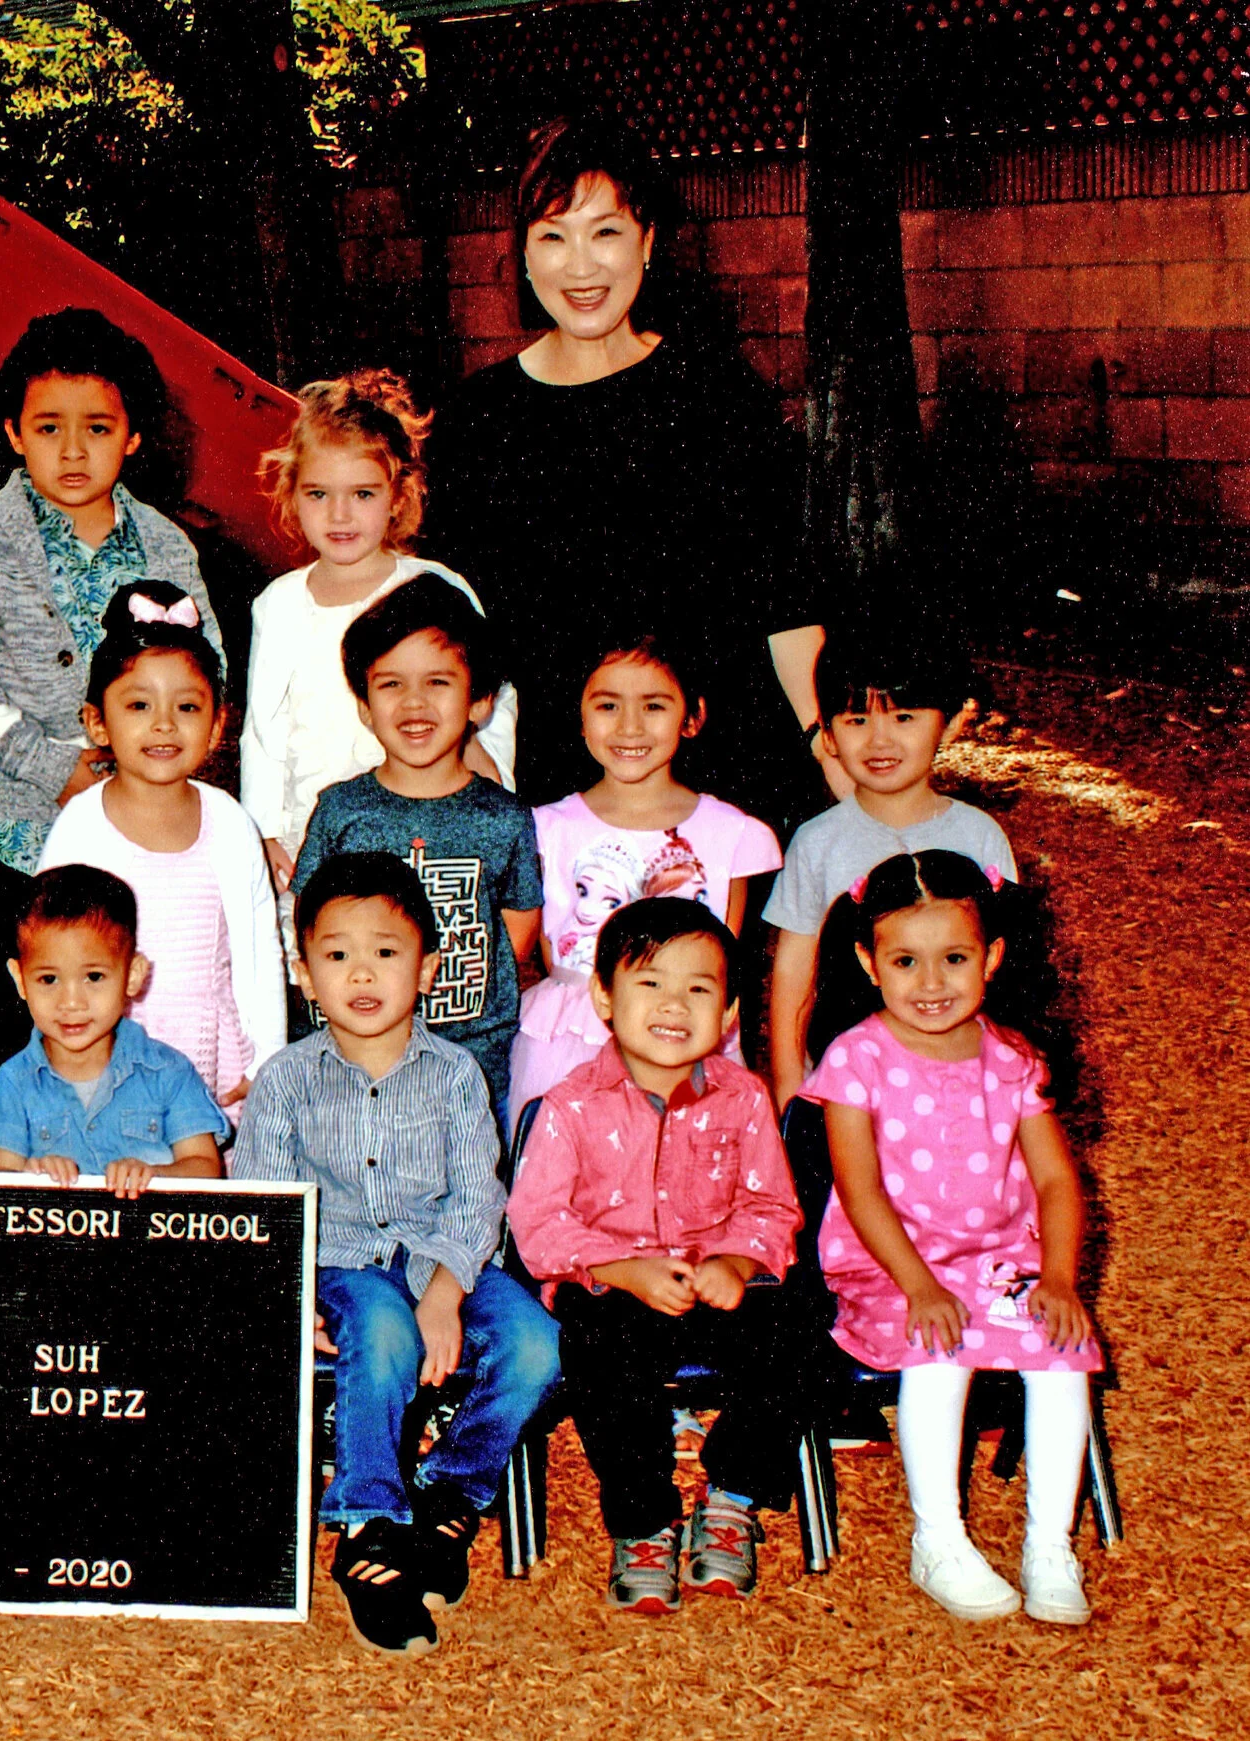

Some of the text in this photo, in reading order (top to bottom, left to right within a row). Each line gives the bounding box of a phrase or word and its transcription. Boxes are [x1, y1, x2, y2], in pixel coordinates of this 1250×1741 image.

[147, 1213, 270, 1243] SCHOOL
[34, 1344, 100, 1373] SUH
[30, 1387, 146, 1418] LOPEZ
[47, 1557, 132, 1588] 2020
